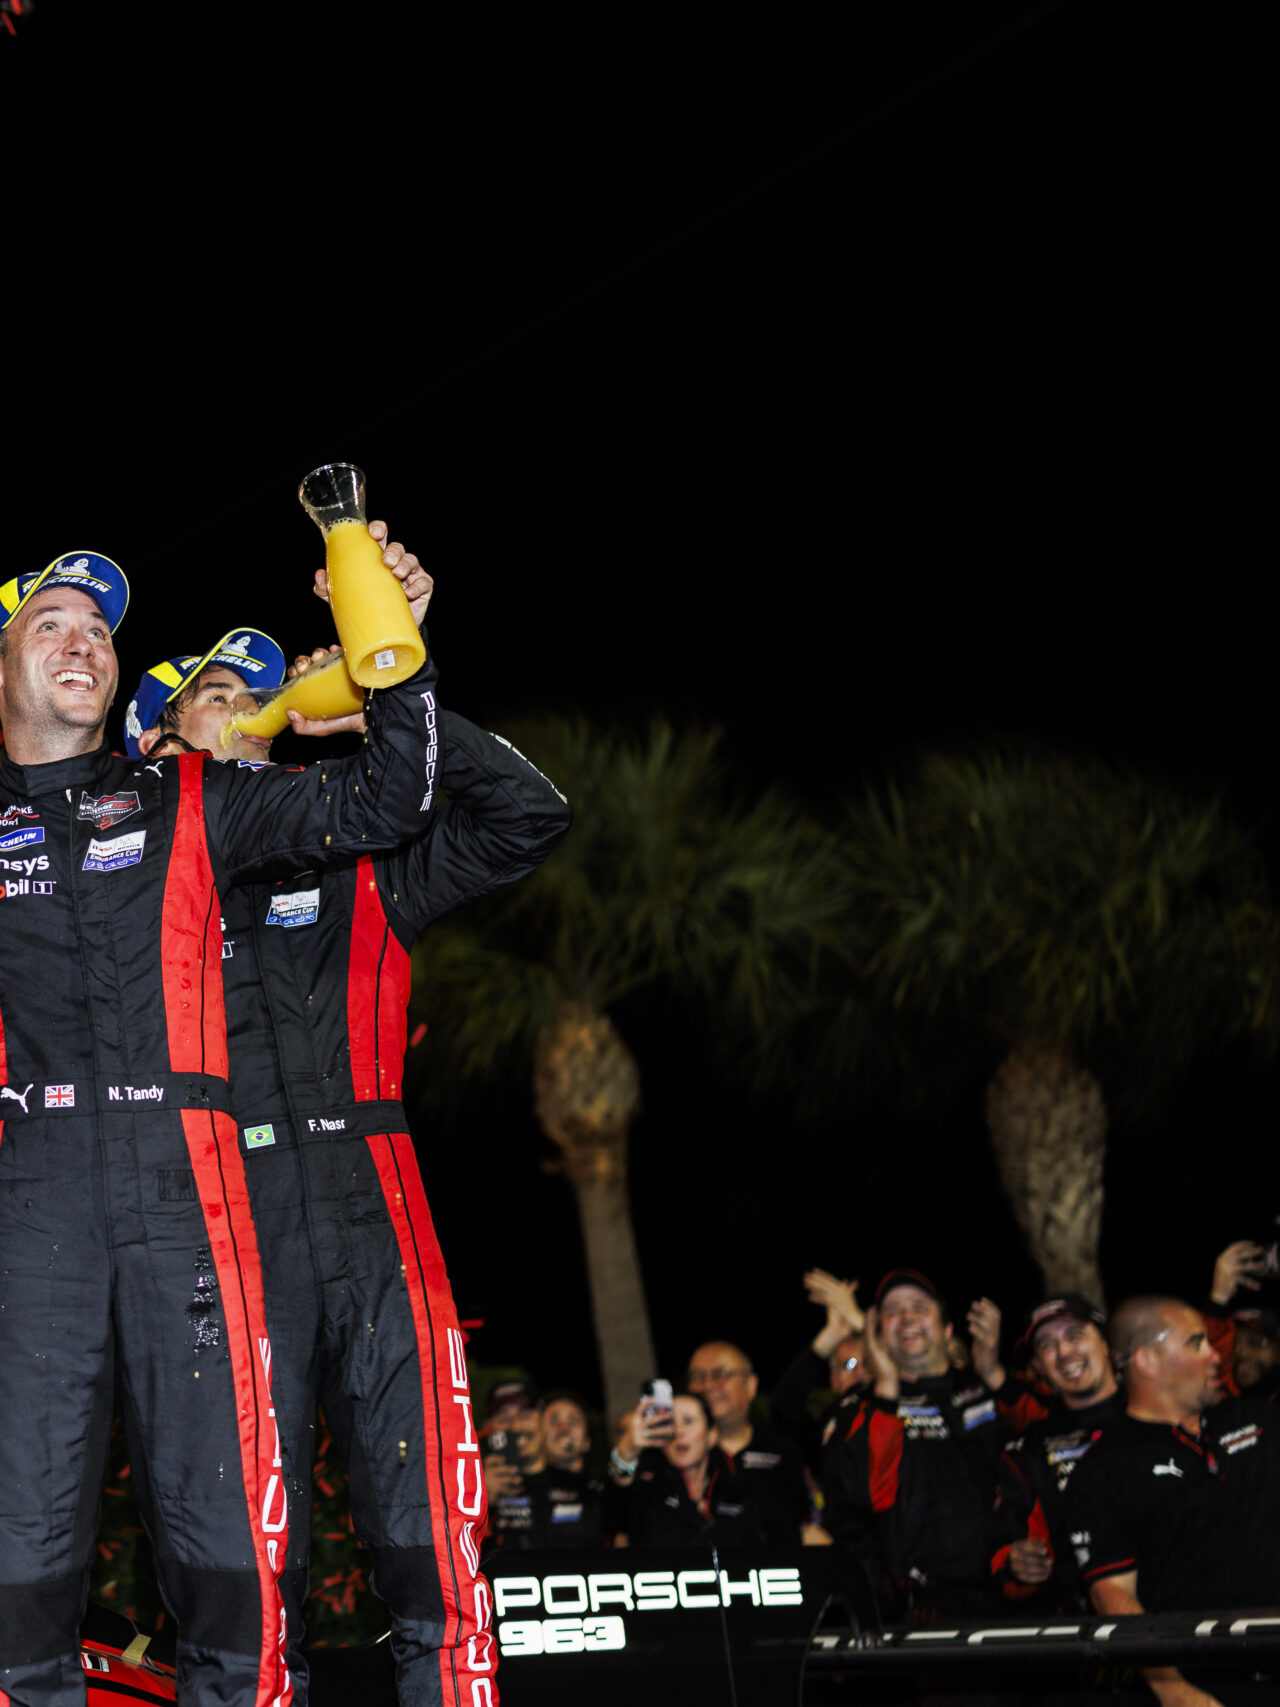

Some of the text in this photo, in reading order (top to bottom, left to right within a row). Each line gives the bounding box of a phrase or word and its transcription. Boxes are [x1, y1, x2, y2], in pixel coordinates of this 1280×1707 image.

[420, 690, 438, 812] PORSCHE
[109, 1085, 164, 1102] N. Tandy
[308, 1118, 345, 1132] F. Nasr
[493, 1568, 803, 1617] PORSCHE
[498, 1615, 626, 1656] 963
